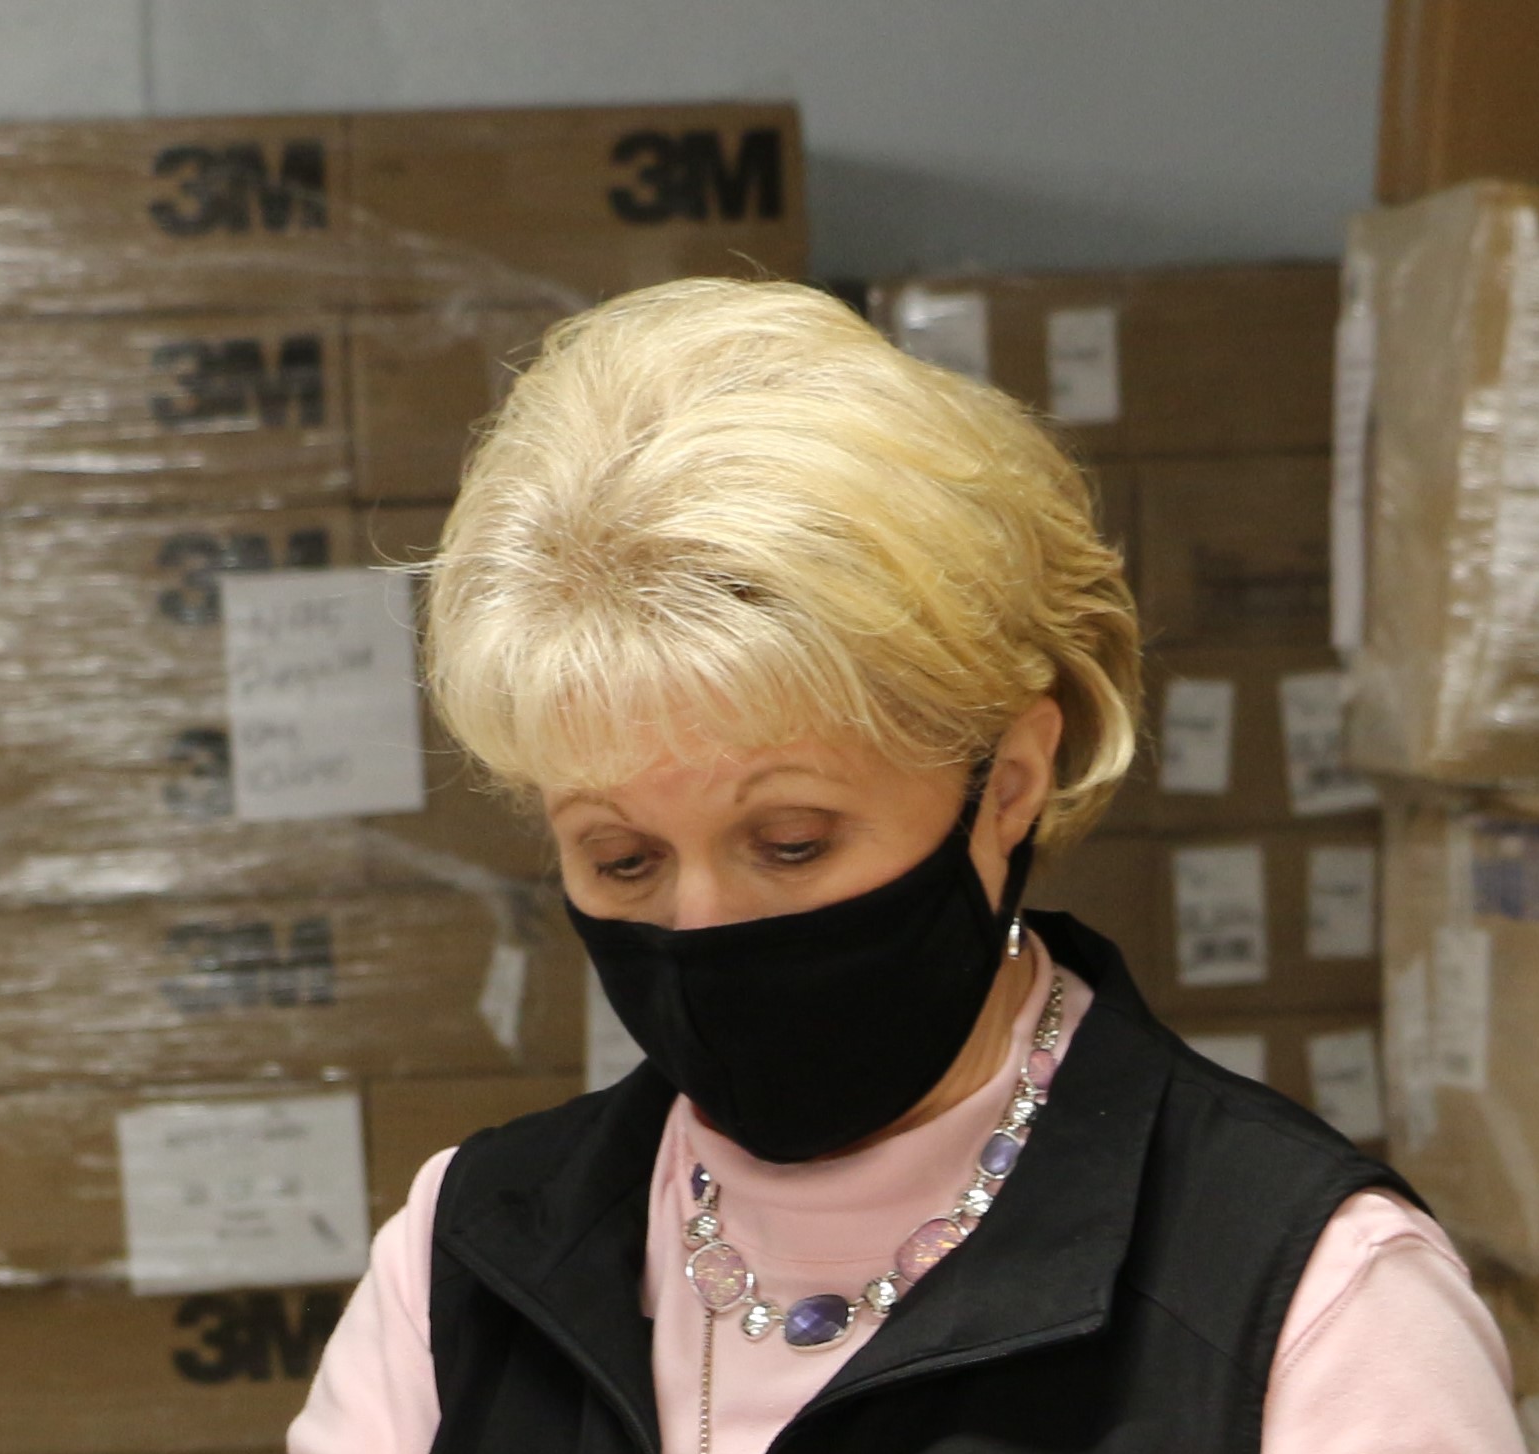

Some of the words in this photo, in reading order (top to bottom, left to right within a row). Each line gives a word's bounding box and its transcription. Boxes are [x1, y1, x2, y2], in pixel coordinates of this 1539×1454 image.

[148, 139, 328, 238] 3M
[608, 128, 783, 224] 3M
[149, 334, 327, 428] 3M
[161, 915, 335, 1013] 3M
